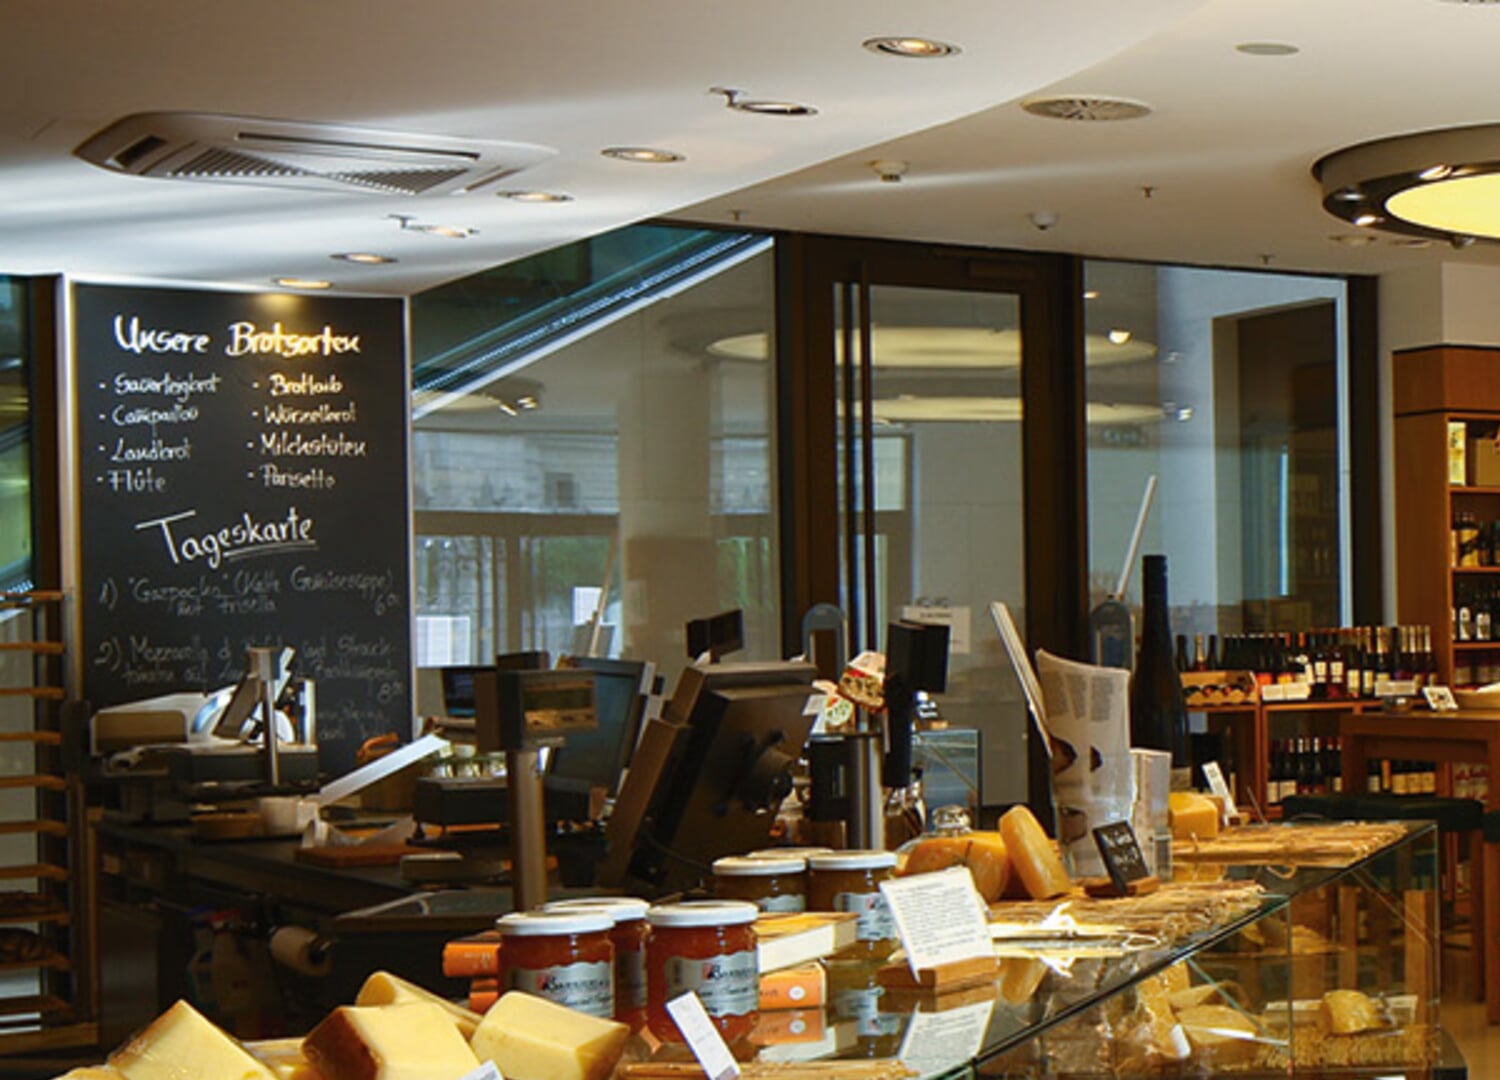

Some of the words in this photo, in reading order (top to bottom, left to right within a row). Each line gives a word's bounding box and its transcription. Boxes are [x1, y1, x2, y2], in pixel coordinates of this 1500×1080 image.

[113, 315, 209, 353] Unsere
[225, 321, 361, 357] Brotsorten
[269, 373, 343, 396] Brotlaib
[111, 438, 191, 461] Landbrot
[134, 507, 312, 569] Tageskarte
